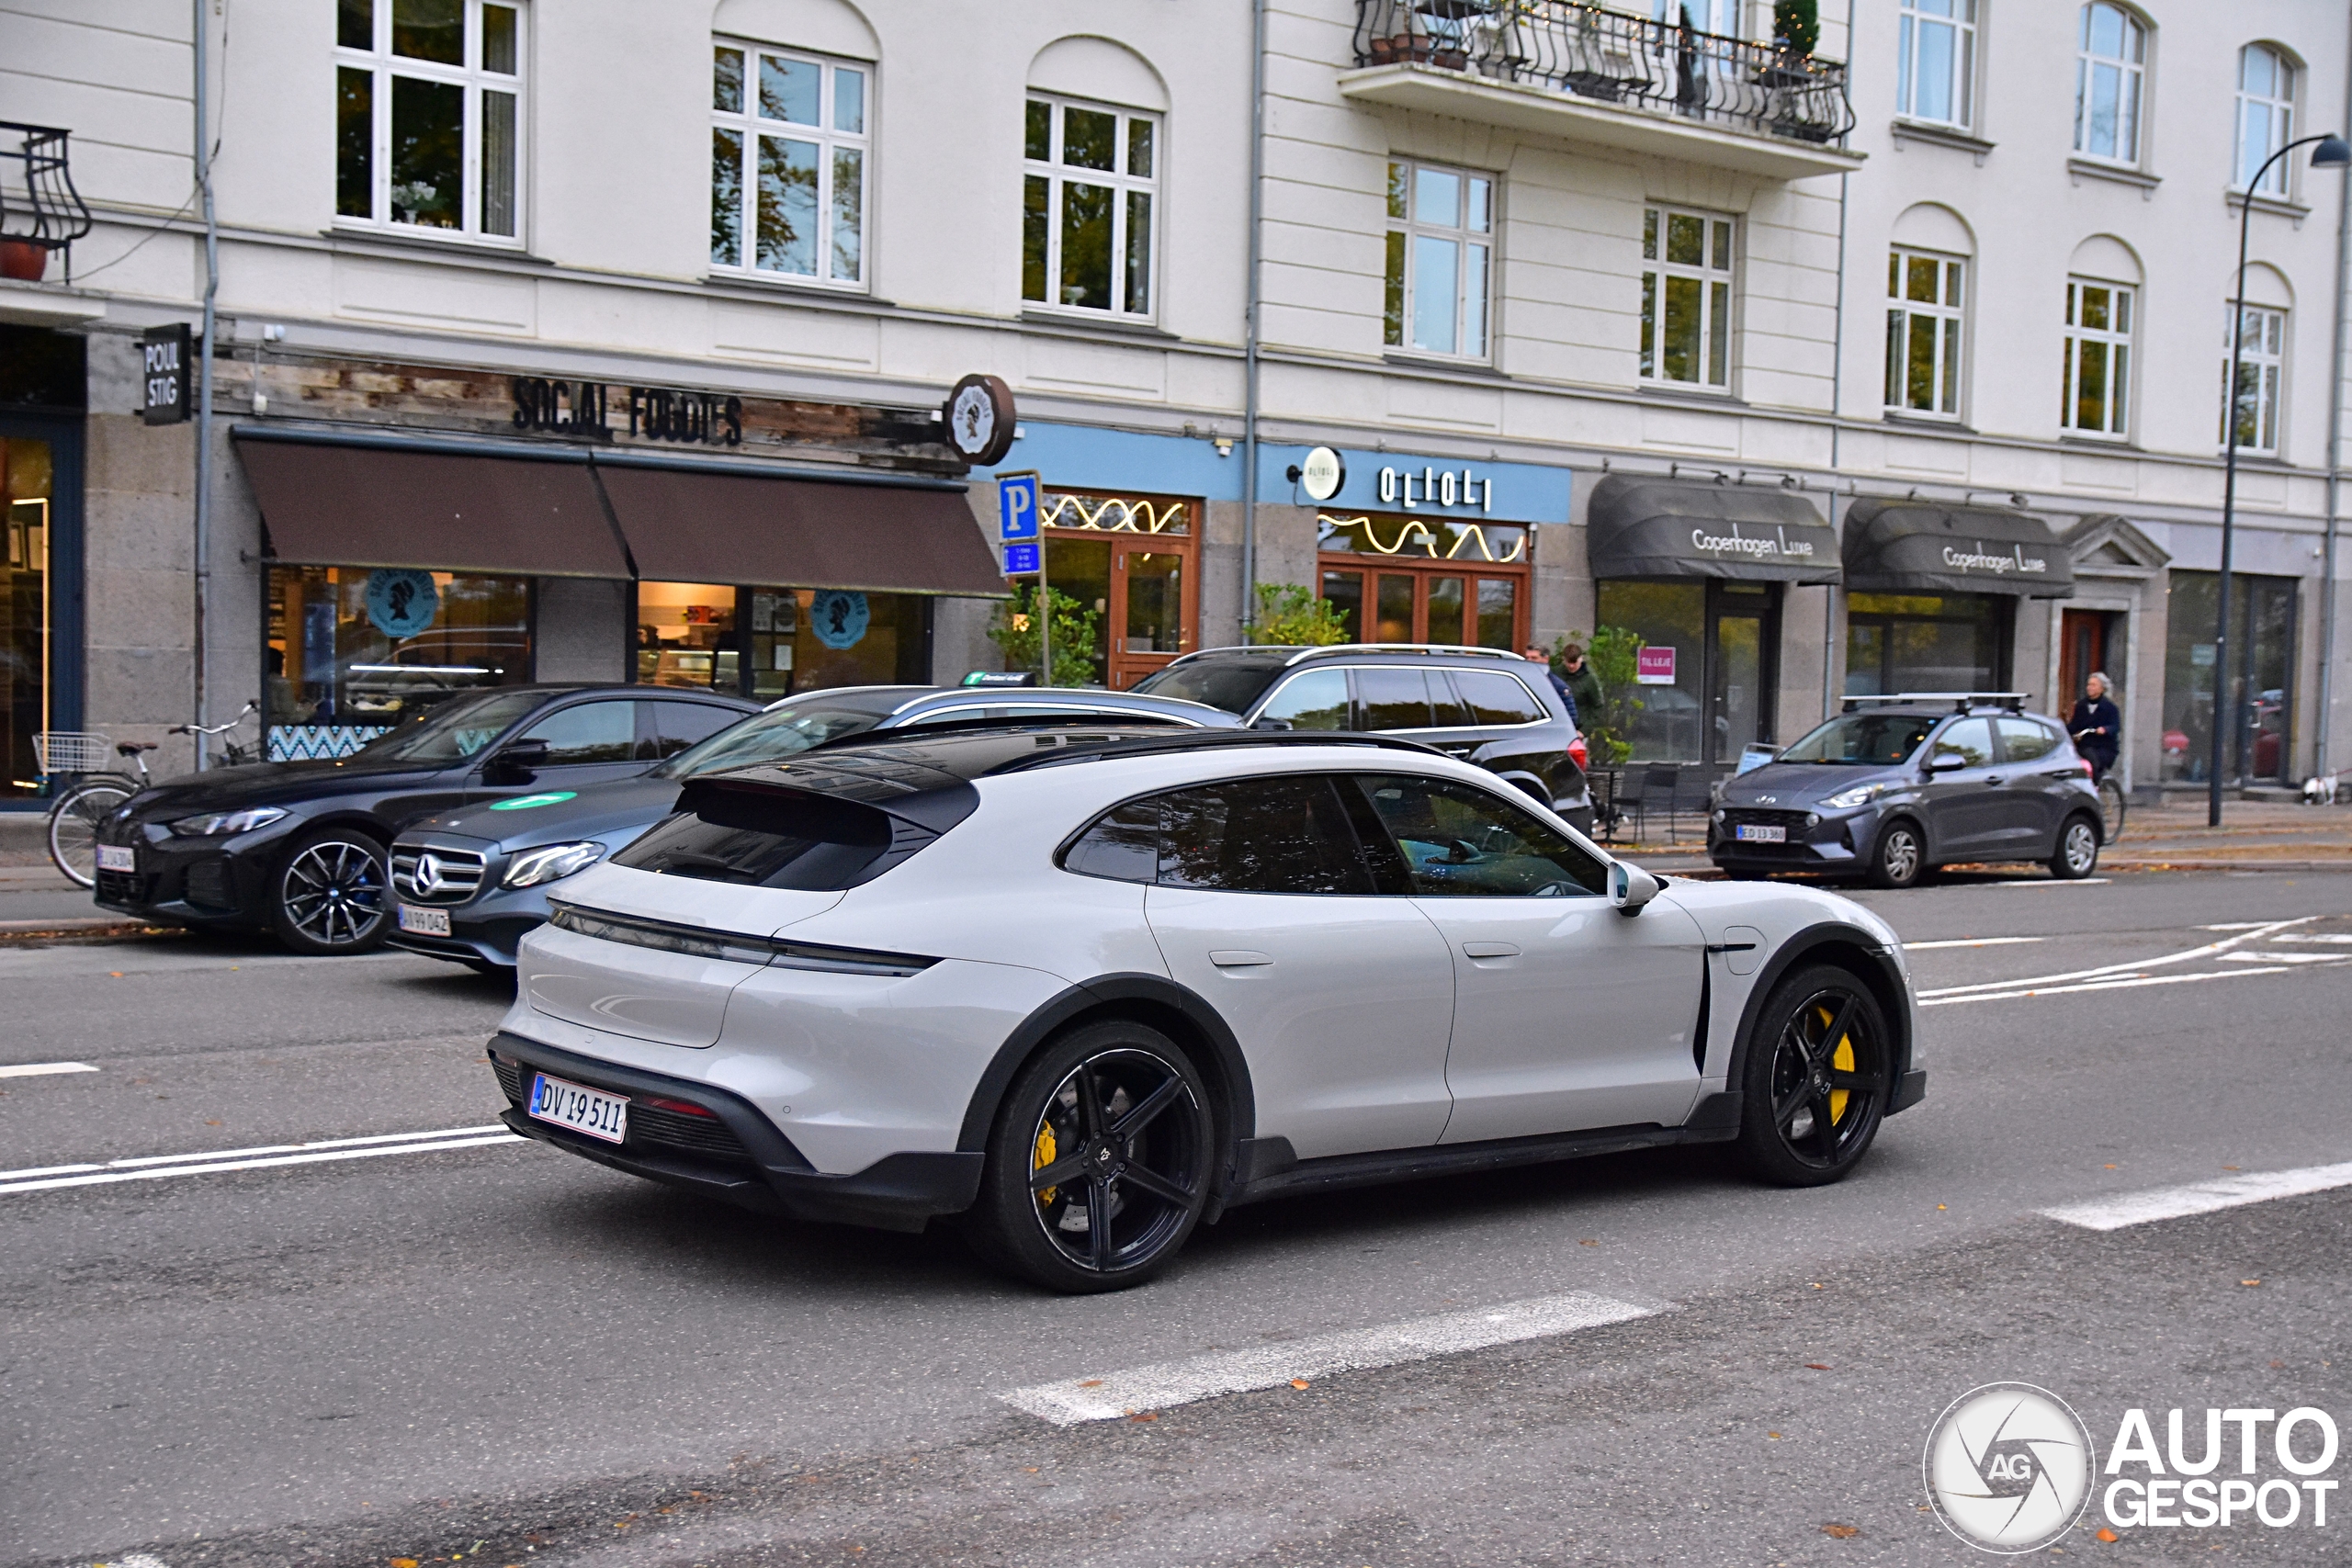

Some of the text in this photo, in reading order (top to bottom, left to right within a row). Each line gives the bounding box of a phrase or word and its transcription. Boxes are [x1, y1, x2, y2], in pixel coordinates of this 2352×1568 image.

[145, 341, 180, 373] POUL
[148, 375, 178, 407] STIG
[513, 377, 742, 446] SOCIAL FOODIES
[1004, 484, 1031, 532] P
[1379, 466, 1492, 513] OLIOLI
[1691, 522, 1814, 558] Copenhagen Luxe
[1941, 540, 2047, 575] Copenhagen Luxe
[540, 1083, 621, 1134] DV 19 511
